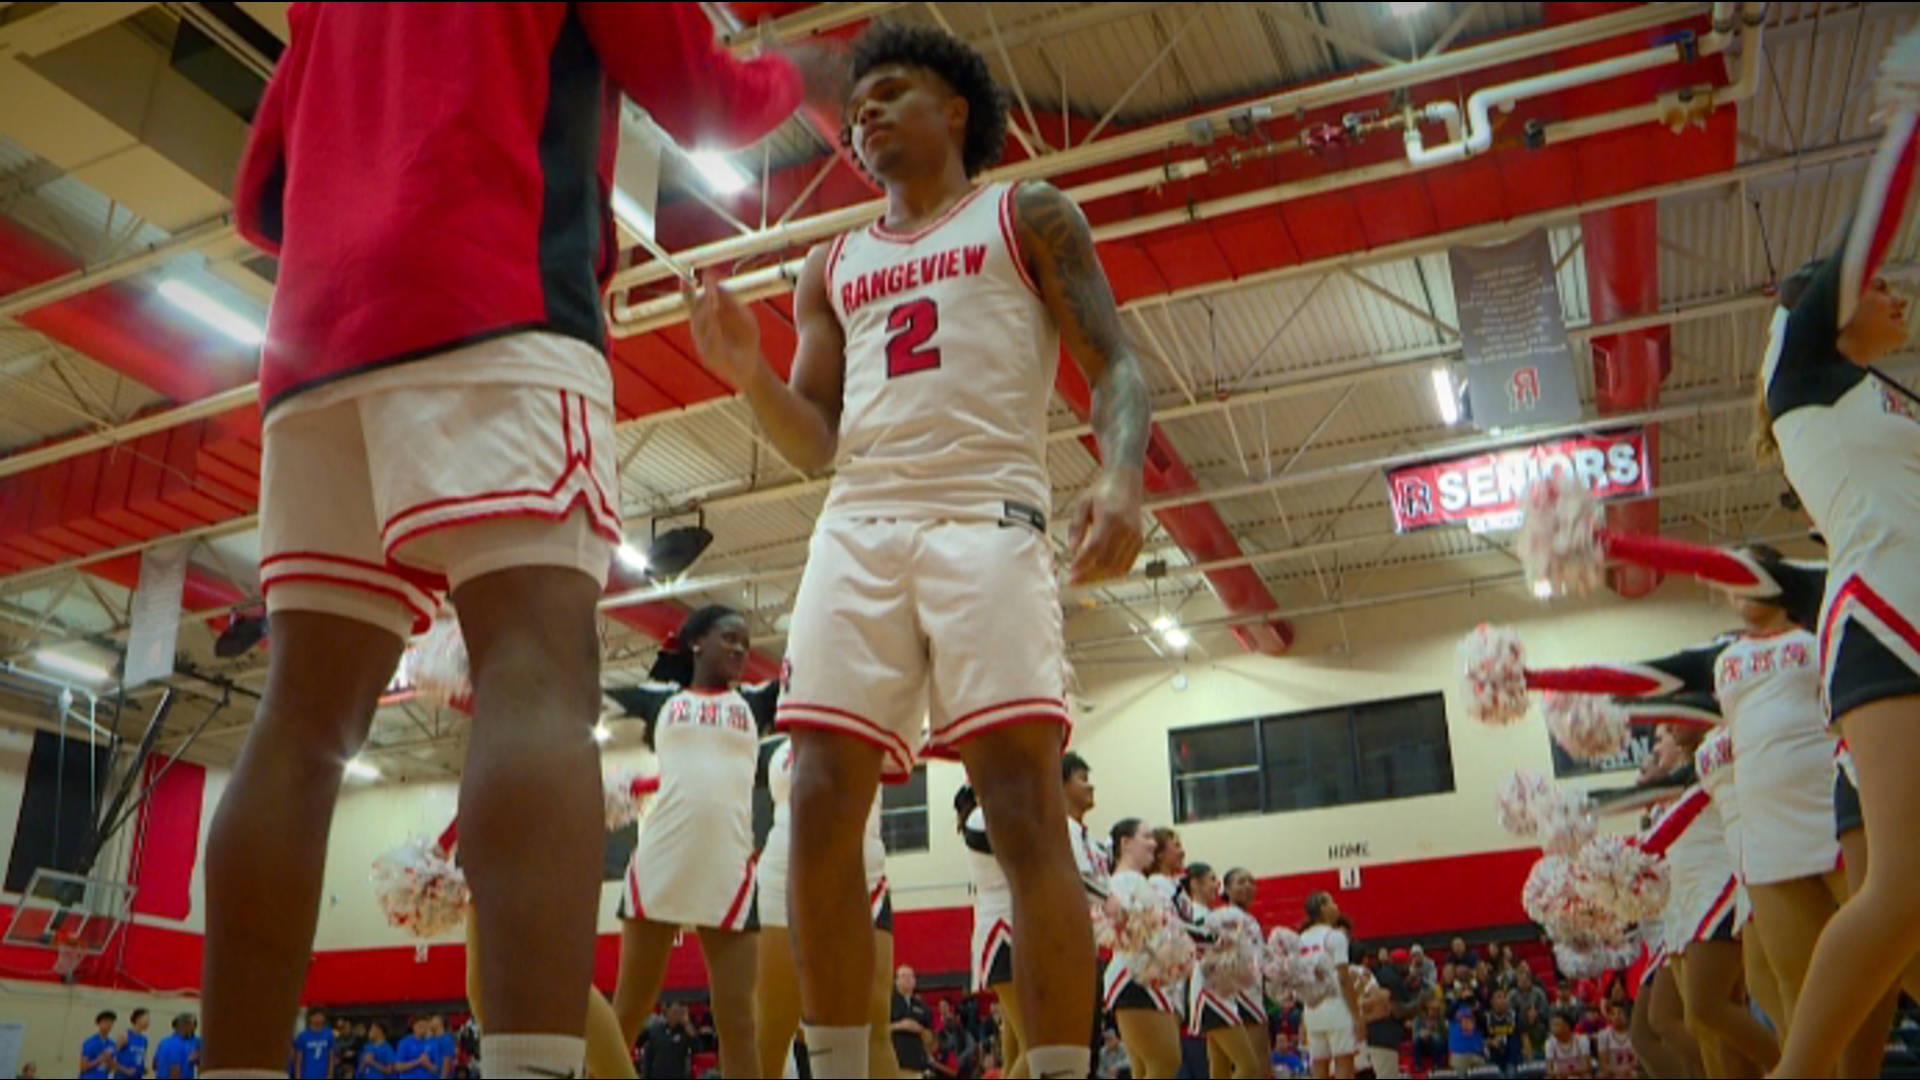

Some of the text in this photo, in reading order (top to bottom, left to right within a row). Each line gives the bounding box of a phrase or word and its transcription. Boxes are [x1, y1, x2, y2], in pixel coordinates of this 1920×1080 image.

[840, 244, 988, 316] RANGEVIEW
[885, 296, 941, 379] 2
[1437, 443, 1640, 512] SENIORS
[1328, 842, 1371, 860] HOME
